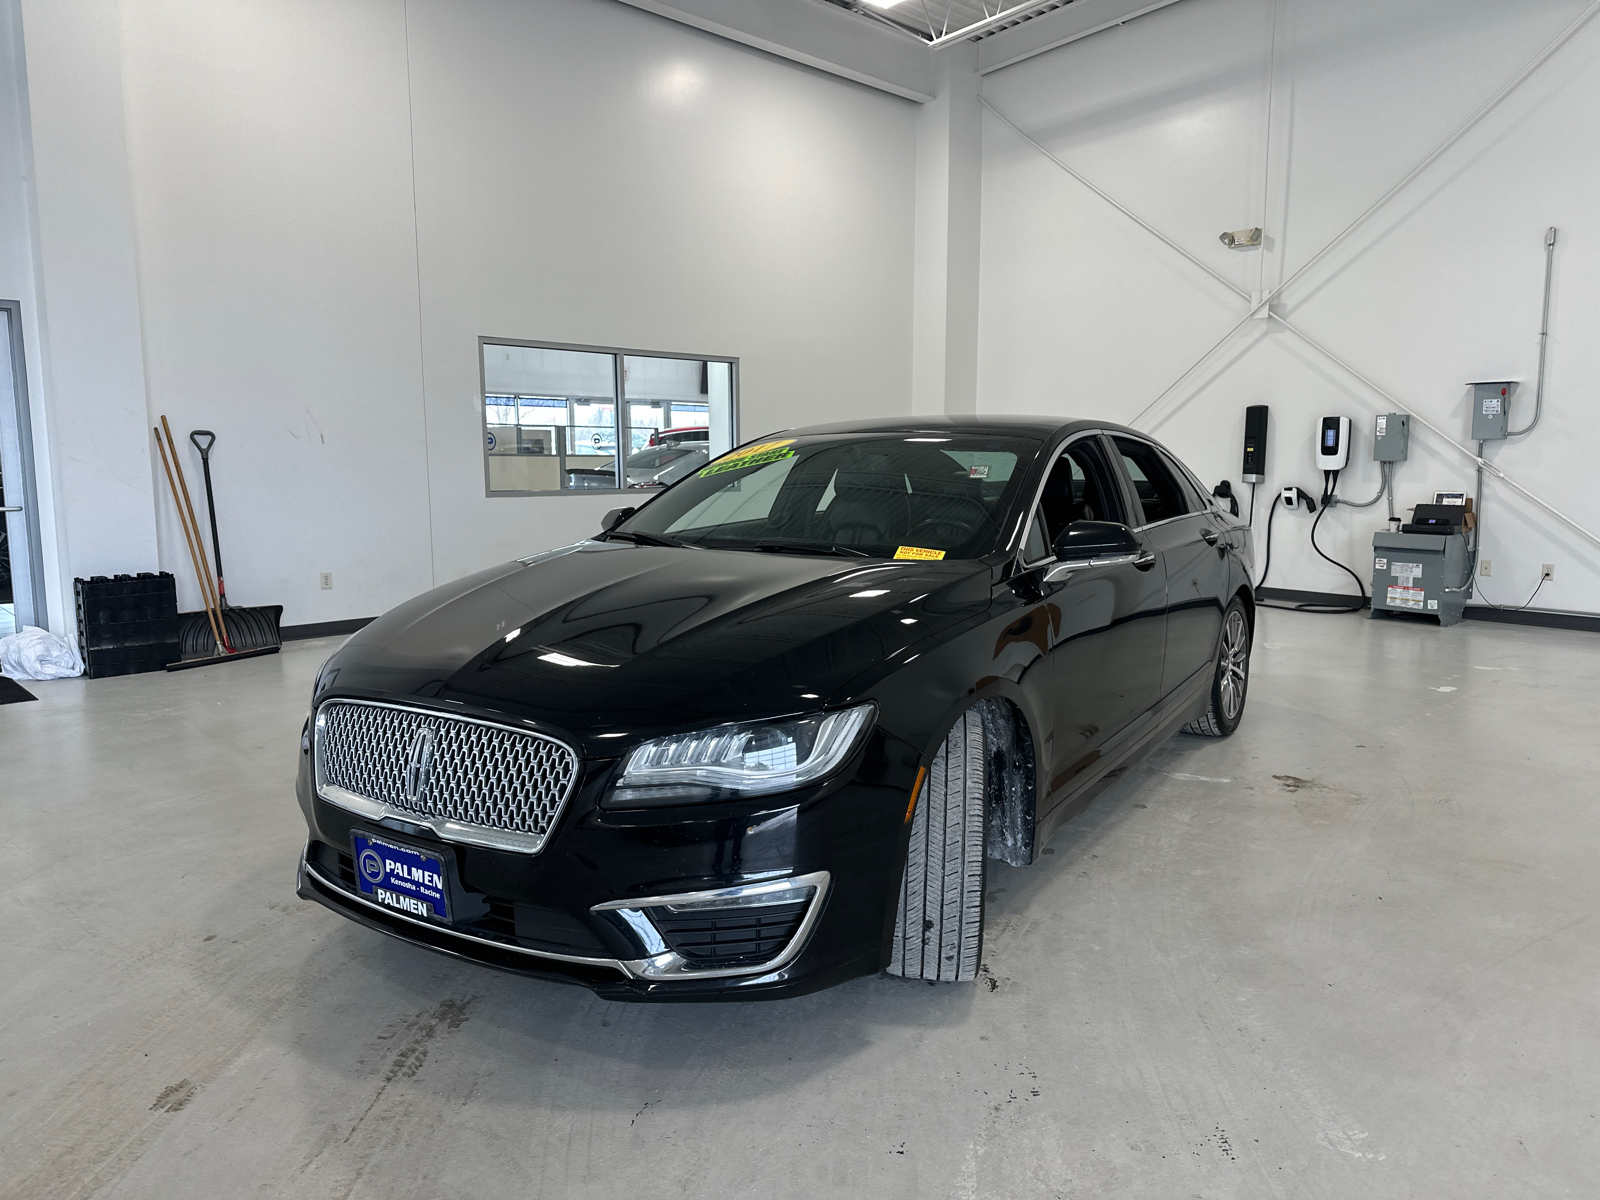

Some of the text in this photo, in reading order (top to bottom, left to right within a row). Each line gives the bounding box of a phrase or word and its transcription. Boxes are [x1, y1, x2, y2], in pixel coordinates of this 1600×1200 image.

[702, 452, 788, 476] LEATHER
[385, 858, 443, 890] PALMEN
[390, 876, 416, 891] Kenosha
[420, 886, 441, 899] Racine
[377, 888, 428, 917] PALMEN
